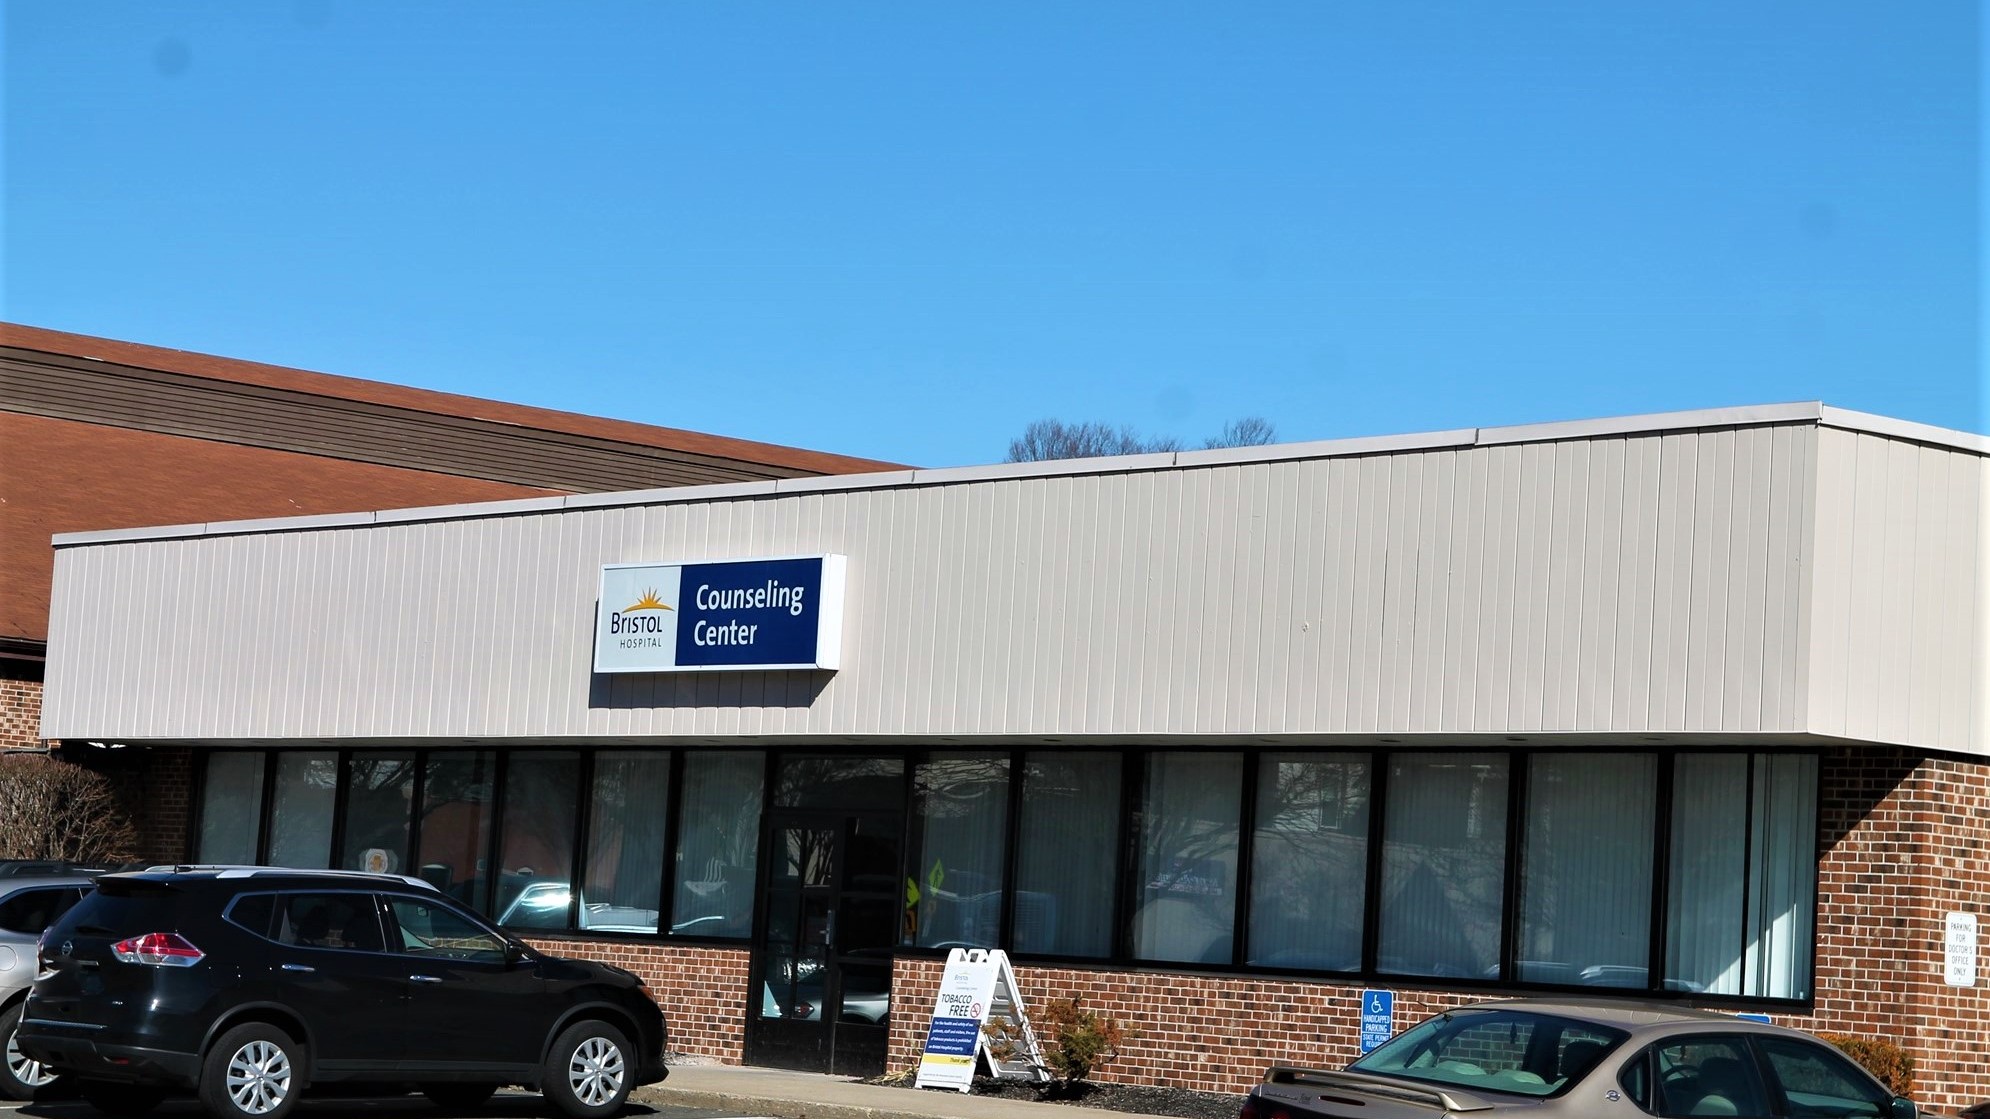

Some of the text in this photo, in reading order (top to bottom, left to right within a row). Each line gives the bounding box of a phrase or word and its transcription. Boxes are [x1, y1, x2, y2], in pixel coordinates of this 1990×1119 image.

[696, 579, 804, 616] Counseling
[694, 619, 758, 646] Center
[620, 638, 662, 649] HOSPITAL
[1951, 923, 1971, 932] PARKING
[1956, 934, 1966, 942] FOR
[1952, 956, 1969, 965] OFFICE
[1954, 967, 1967, 976] ONLY
[942, 994, 972, 1004] TOBACCO
[949, 1004, 970, 1017] FREE
[1363, 1014, 1390, 1024] HANDICAPPED
[1366, 1024, 1387, 1032] PARKING
